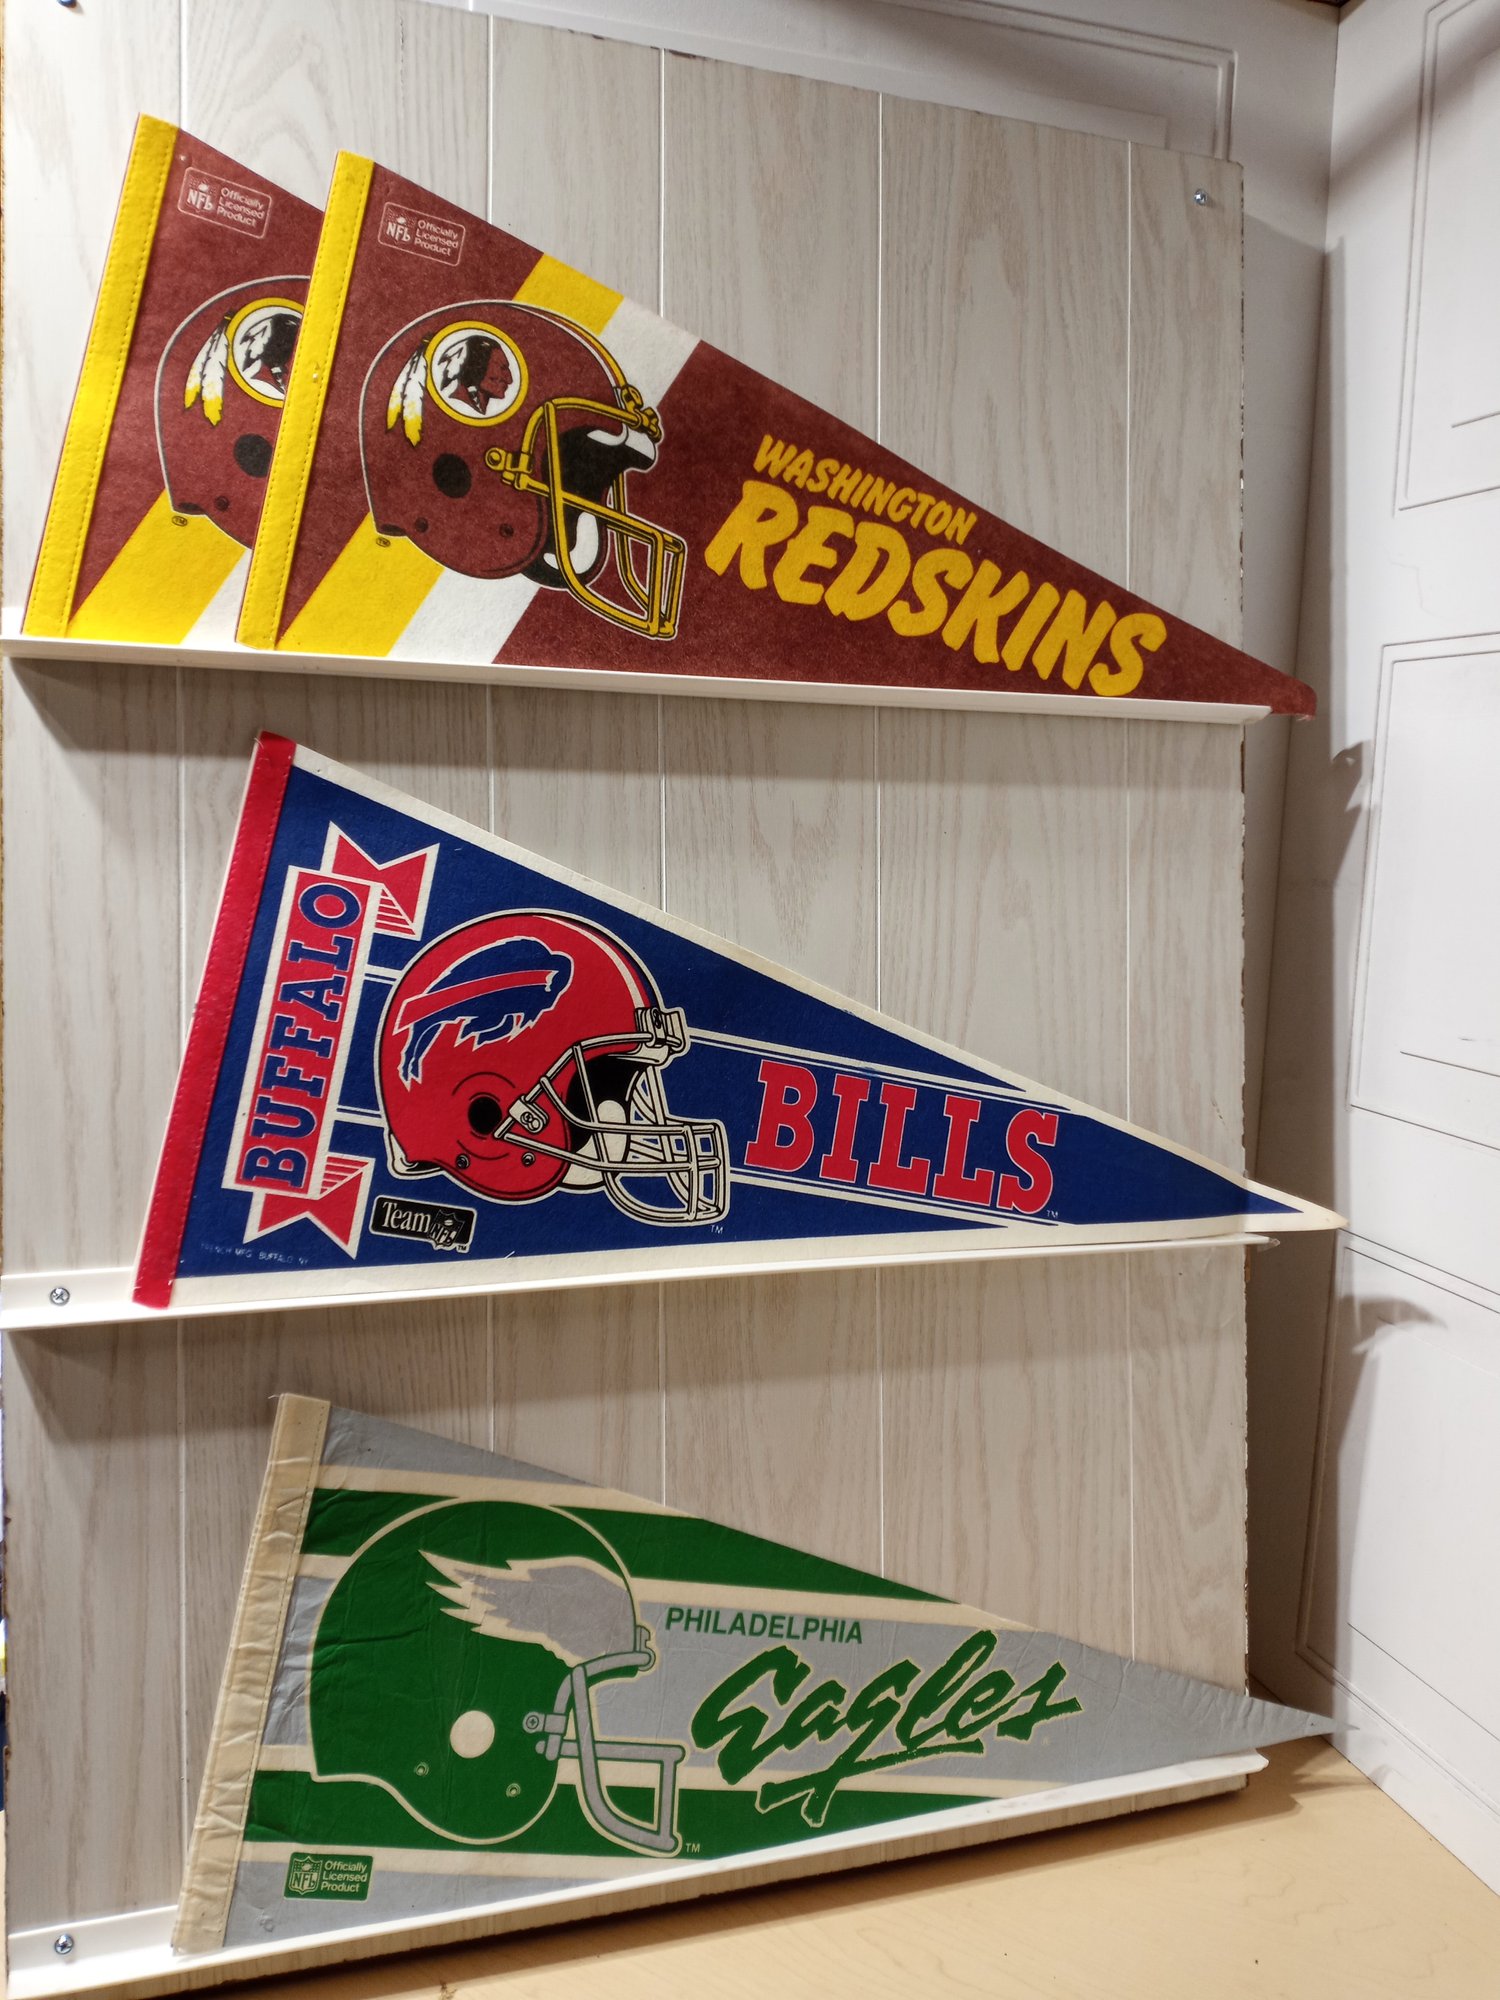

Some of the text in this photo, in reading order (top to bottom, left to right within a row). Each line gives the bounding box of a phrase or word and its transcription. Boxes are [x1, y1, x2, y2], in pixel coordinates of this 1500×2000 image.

[187, 189, 213, 211] NFL
[219, 197, 265, 219] Licensed
[220, 187, 264, 211] Officially
[217, 206, 256, 227] Product
[386, 221, 411, 242] NFL
[416, 228, 459, 249] Licensed
[417, 219, 458, 240] Officially
[414, 237, 451, 256] Product
[753, 433, 977, 545] WASHINGTON
[704, 479, 1167, 697] REDSKINS
[243, 882, 362, 1190] BUFFALO
[744, 1059, 1059, 1215] BILLS
[382, 1201, 432, 1233] Team
[709, 1225, 723, 1235] TM
[664, 1606, 863, 1645] PHILADELPHIA
[690, 1629, 1083, 1828] Eagles
[685, 1842, 700, 1853] TM
[322, 1870, 368, 1882] Licensed
[324, 1860, 367, 1874] Officially
[292, 1872, 318, 1891] NFL
[320, 1881, 360, 1892] Product
